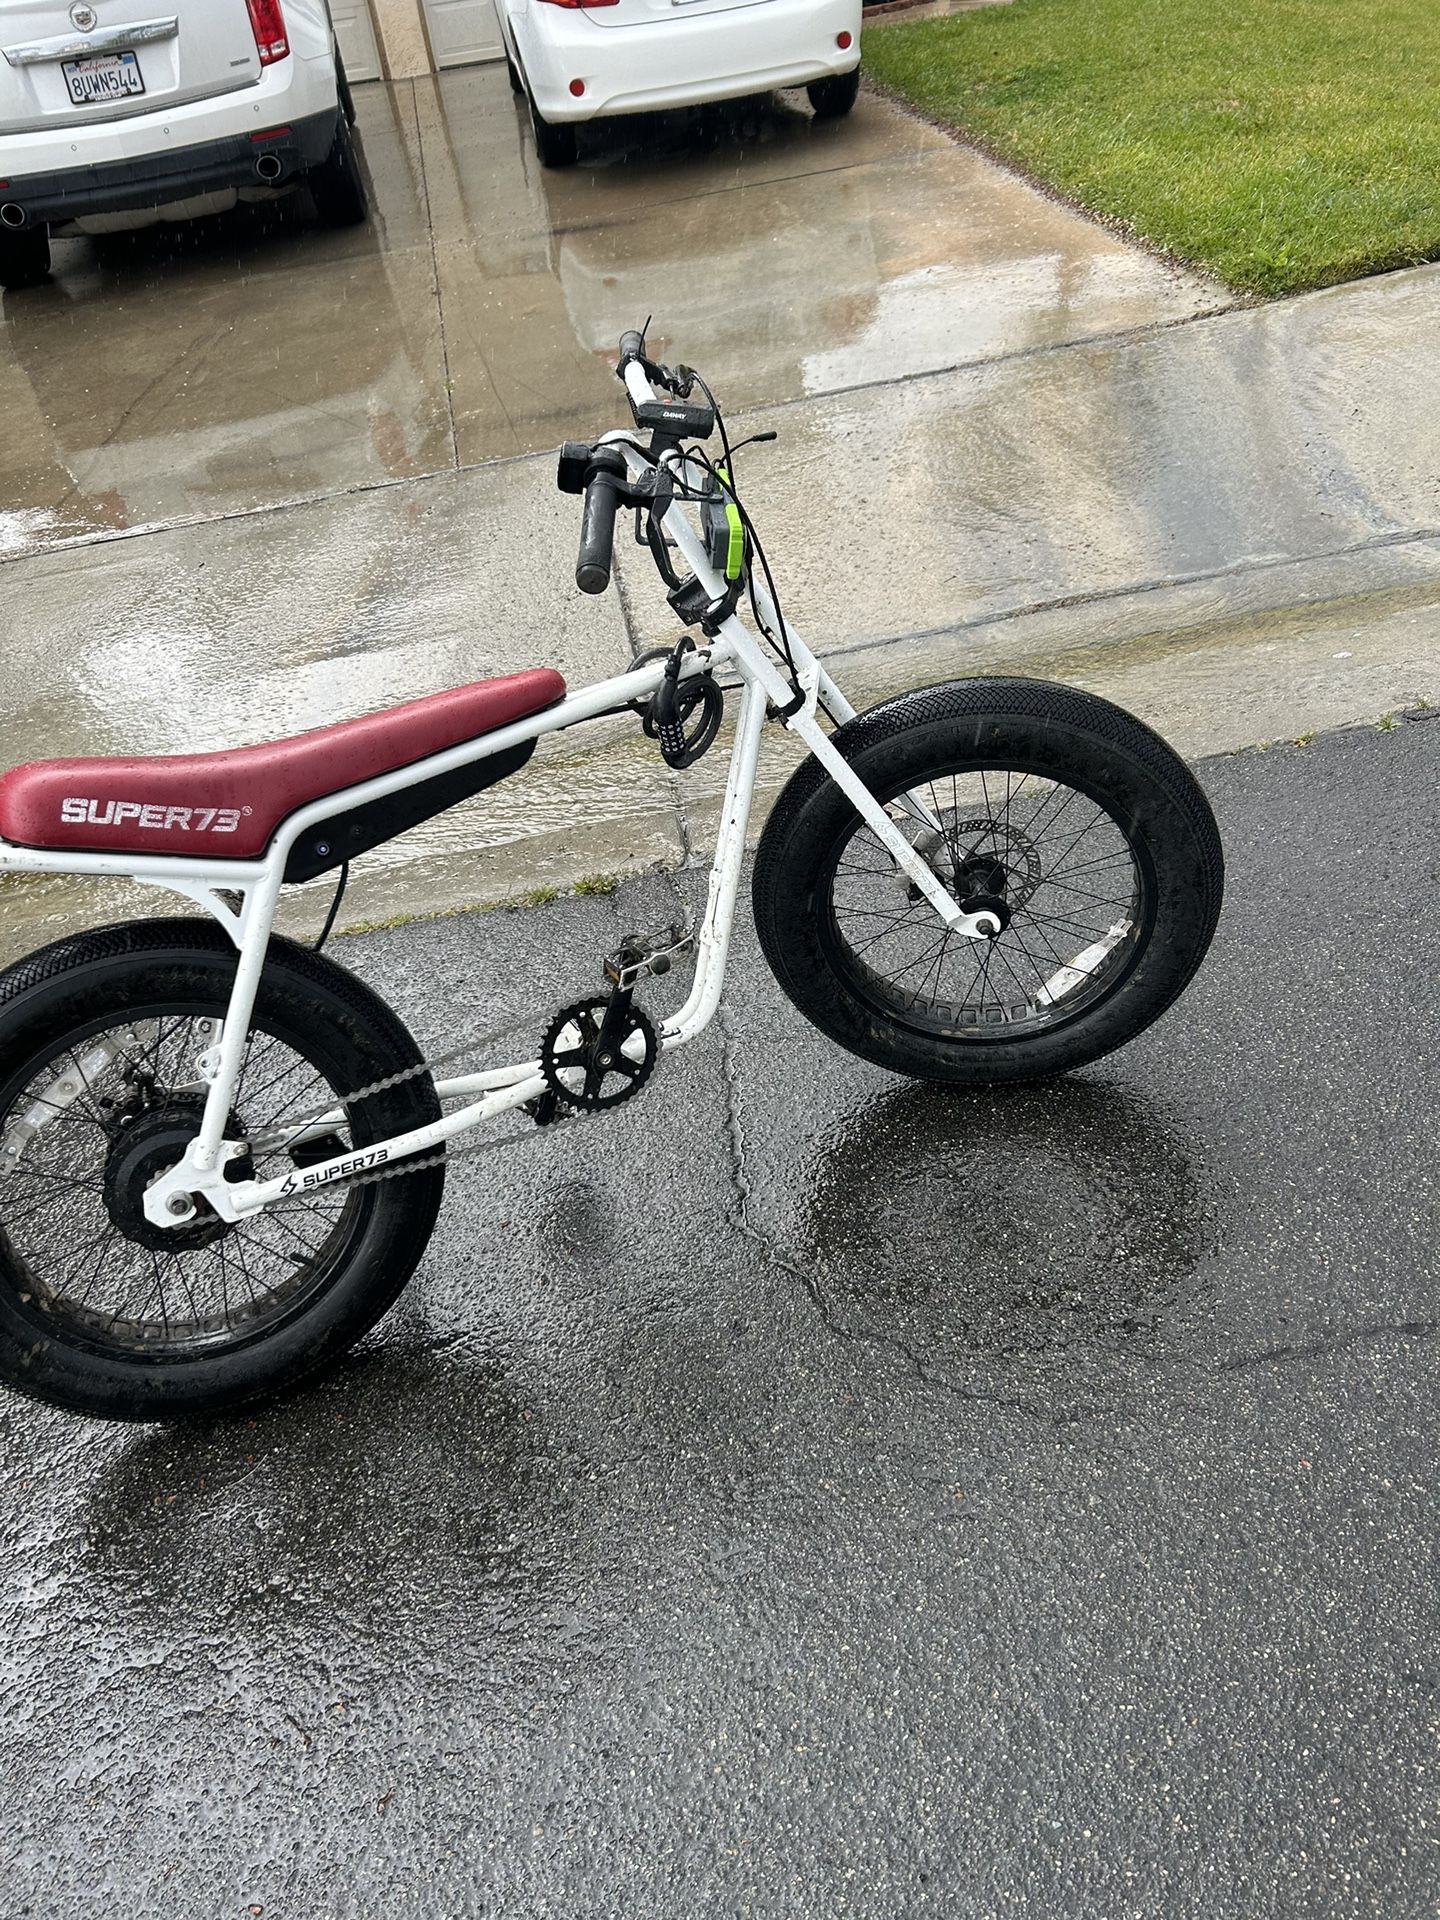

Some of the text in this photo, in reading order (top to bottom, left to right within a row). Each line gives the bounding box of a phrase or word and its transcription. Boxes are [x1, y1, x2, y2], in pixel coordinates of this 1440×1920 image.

[72, 68, 138, 97] 8UWN544
[79, 60, 119, 73] California
[61, 797, 242, 832] SUPER73
[303, 1149, 389, 1187] SUPER73
